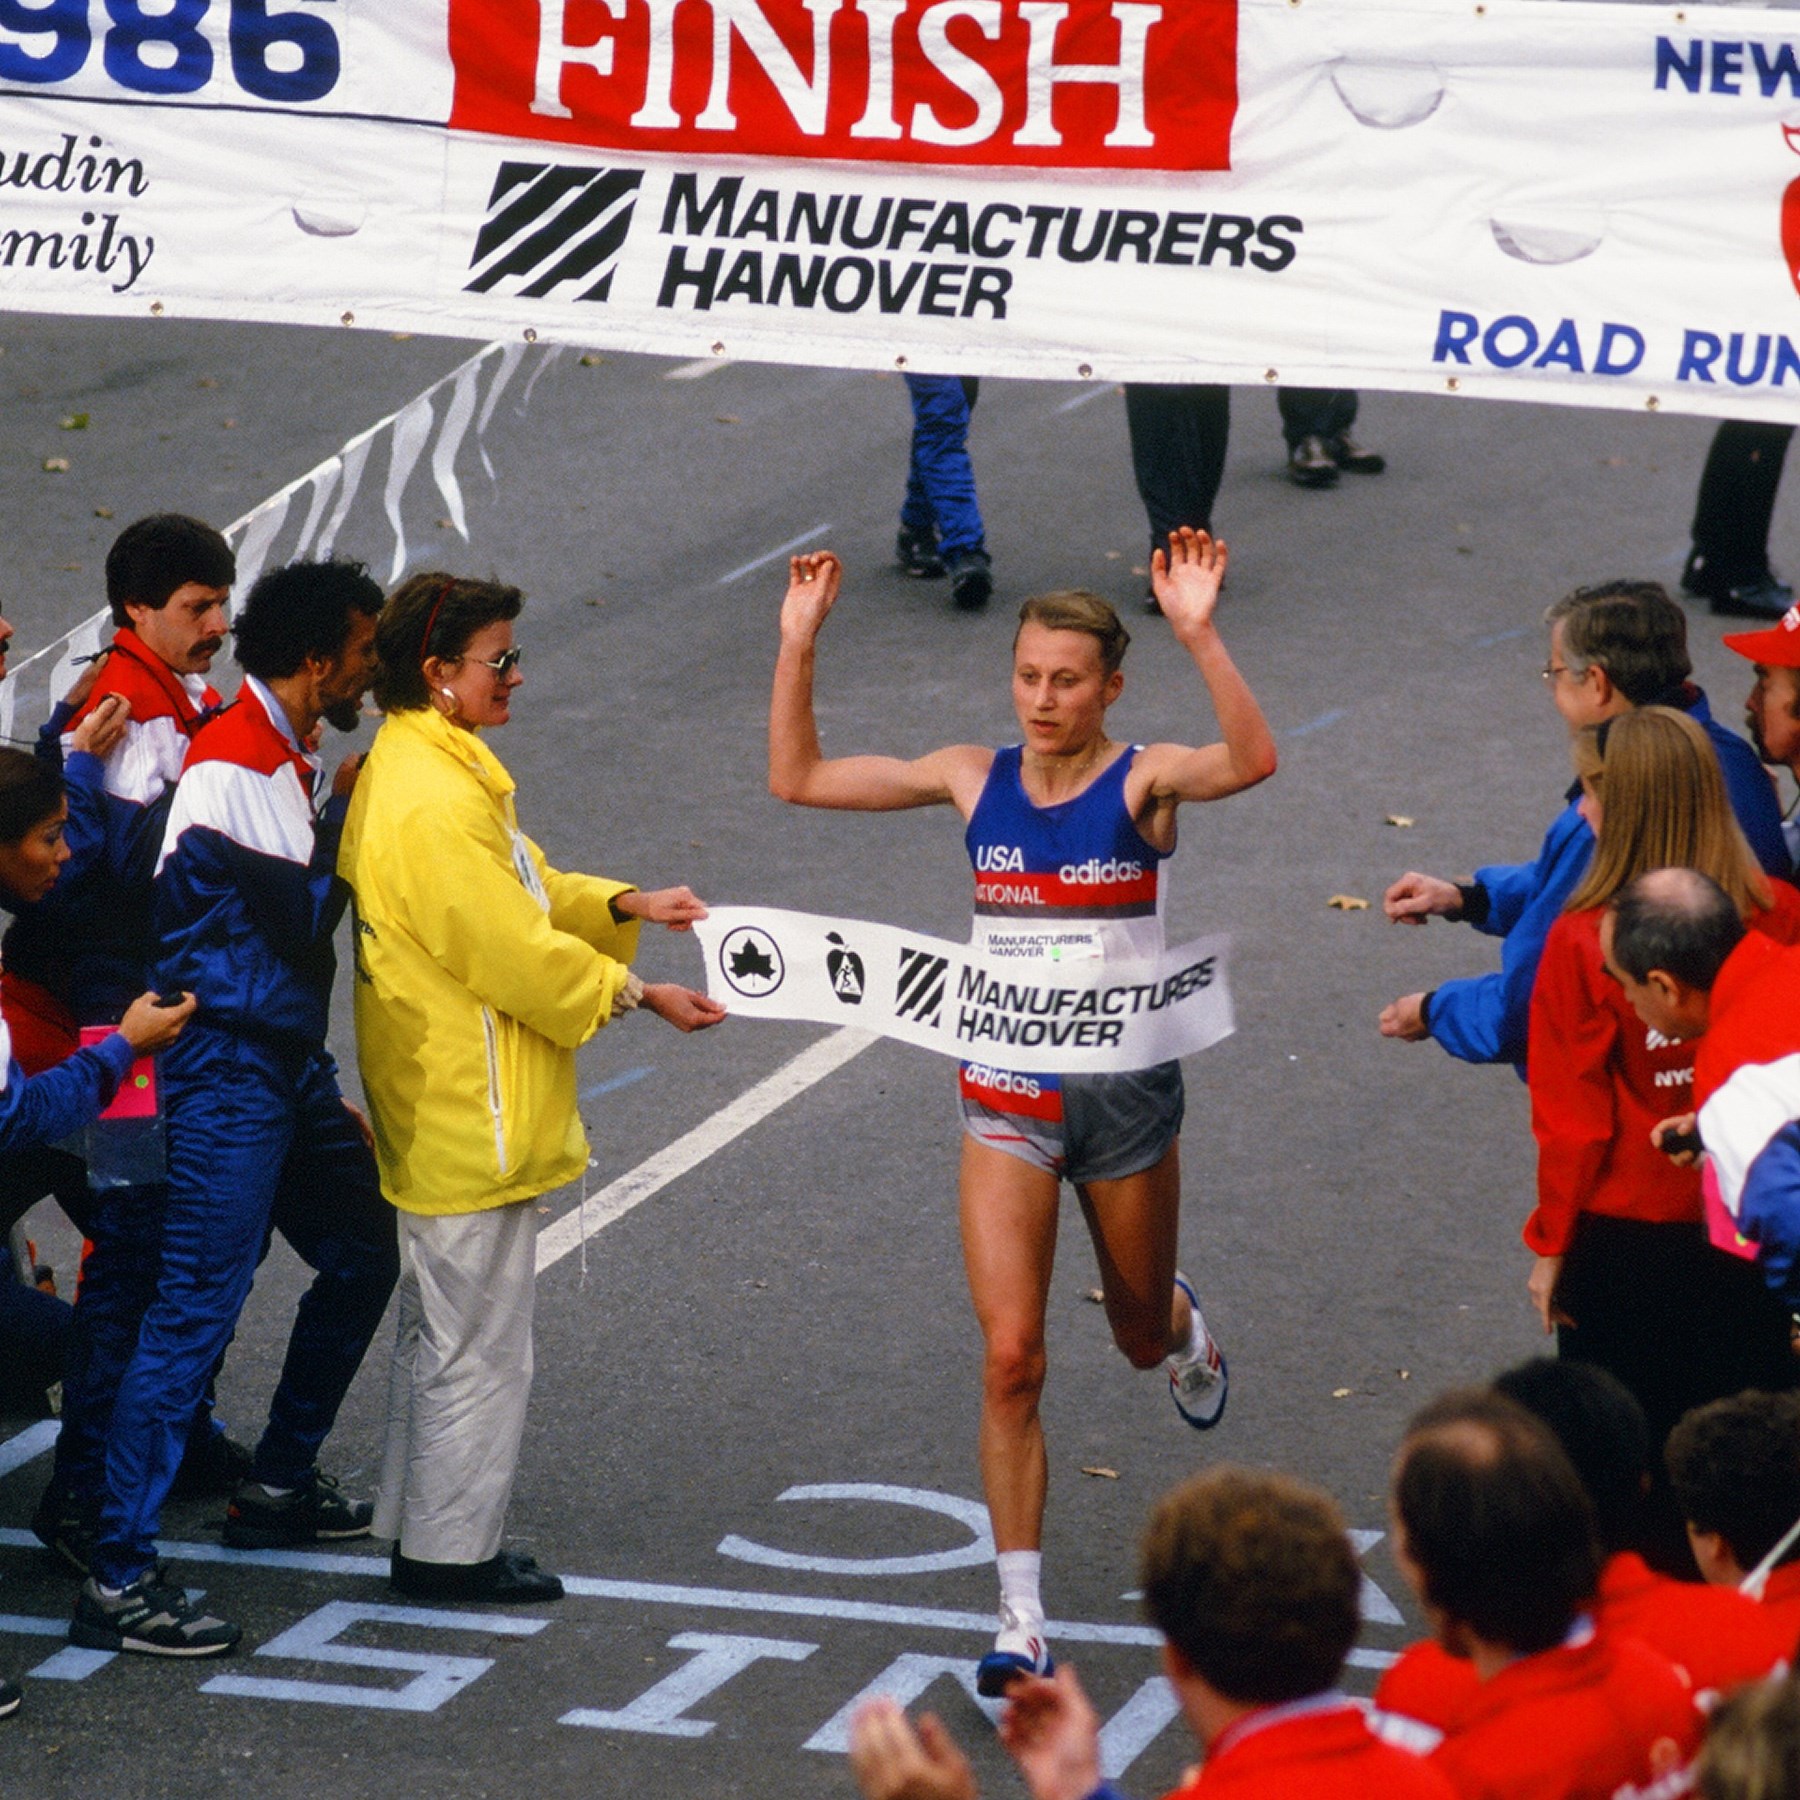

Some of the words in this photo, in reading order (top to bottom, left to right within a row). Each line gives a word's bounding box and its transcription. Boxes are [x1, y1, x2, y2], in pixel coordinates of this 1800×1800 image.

[530, 0, 1162, 149] FINISH
[1654, 36, 1800, 99] NEW
[659, 172, 1304, 272] MANUFACTURERS
[656, 245, 1013, 320] HANOVER
[1432, 309, 1646, 376] ROAD
[976, 845, 1025, 873] USA
[1059, 857, 1143, 885] adidas
[988, 934, 1093, 946] MANUFACTURERS
[957, 955, 1217, 1017] MANUFACTURERS
[956, 1005, 1124, 1047] HANOVER
[964, 1063, 1041, 1099] adidas
